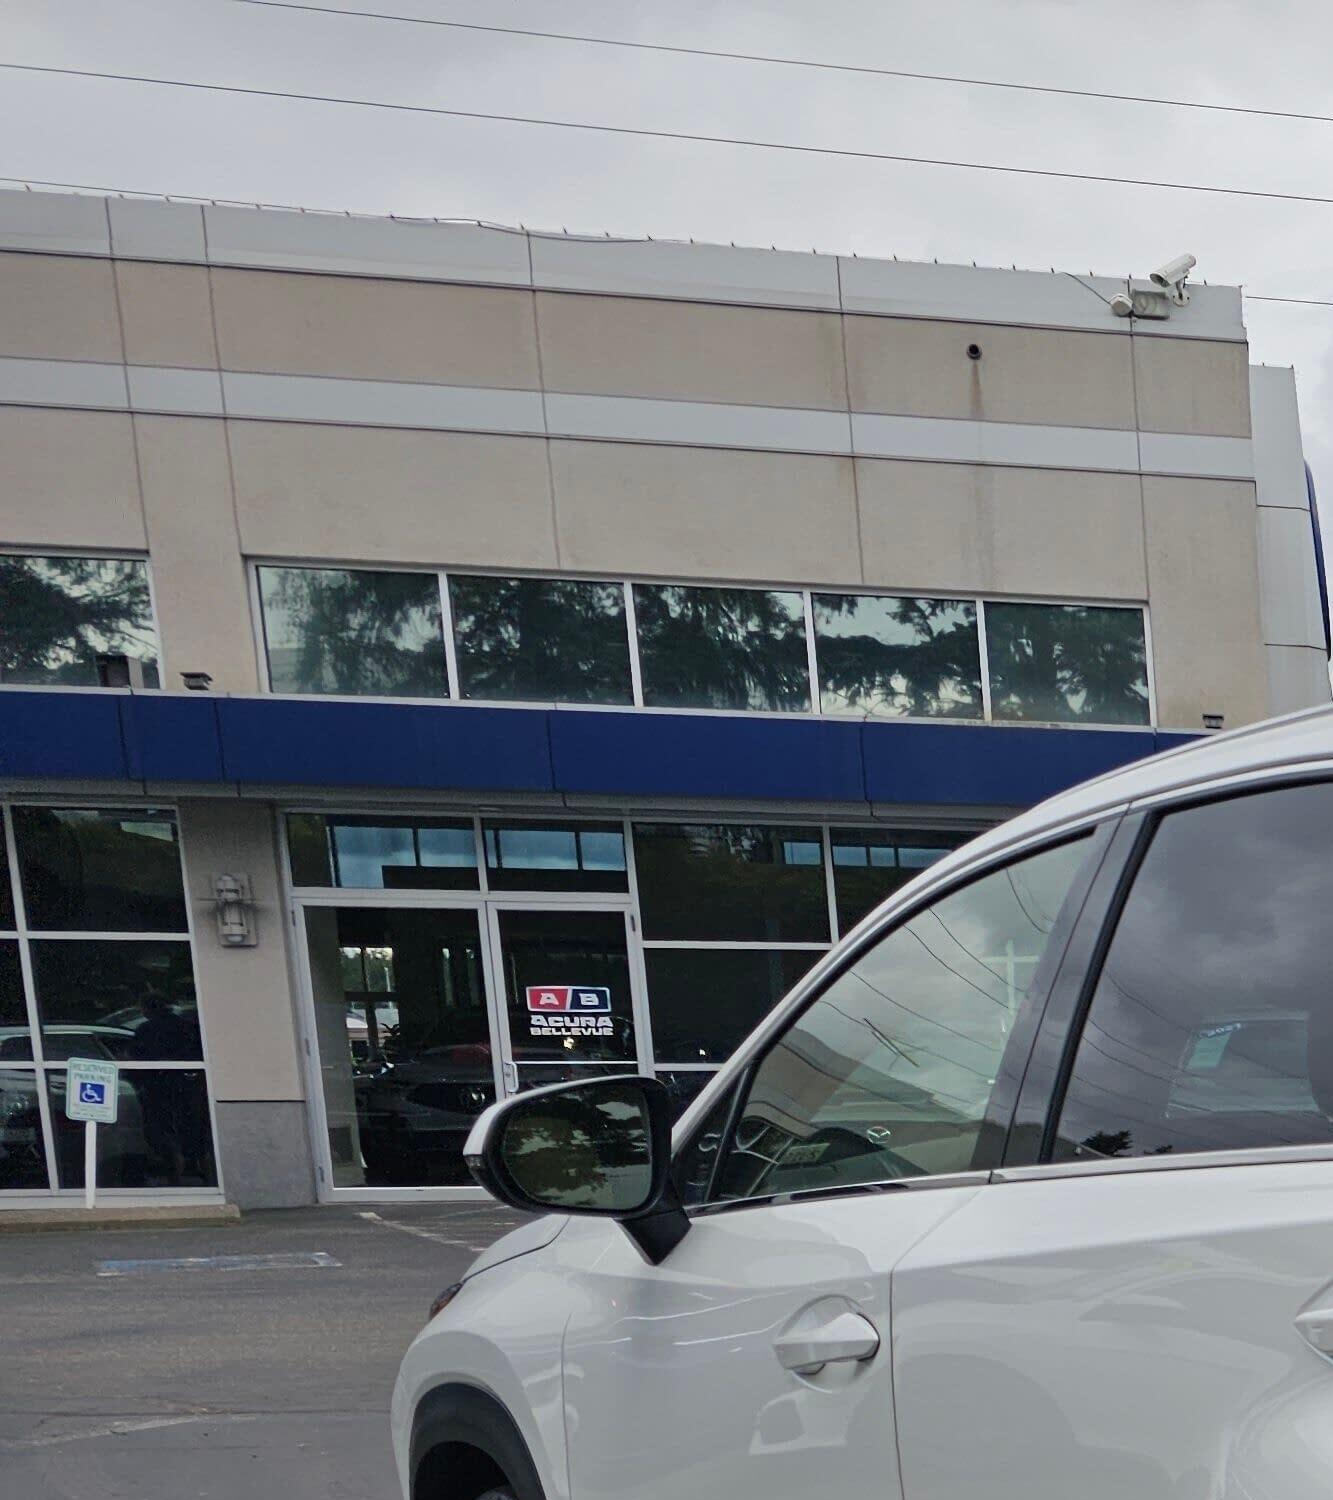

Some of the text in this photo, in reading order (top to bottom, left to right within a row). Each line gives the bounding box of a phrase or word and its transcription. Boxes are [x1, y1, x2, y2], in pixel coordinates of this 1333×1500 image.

[539, 993, 600, 1006] A B
[530, 1014, 614, 1027] ACURA
[530, 1027, 614, 1036] BELLEVUE
[71, 1062, 114, 1074] RESERVED
[73, 1073, 112, 1084] PARKING
